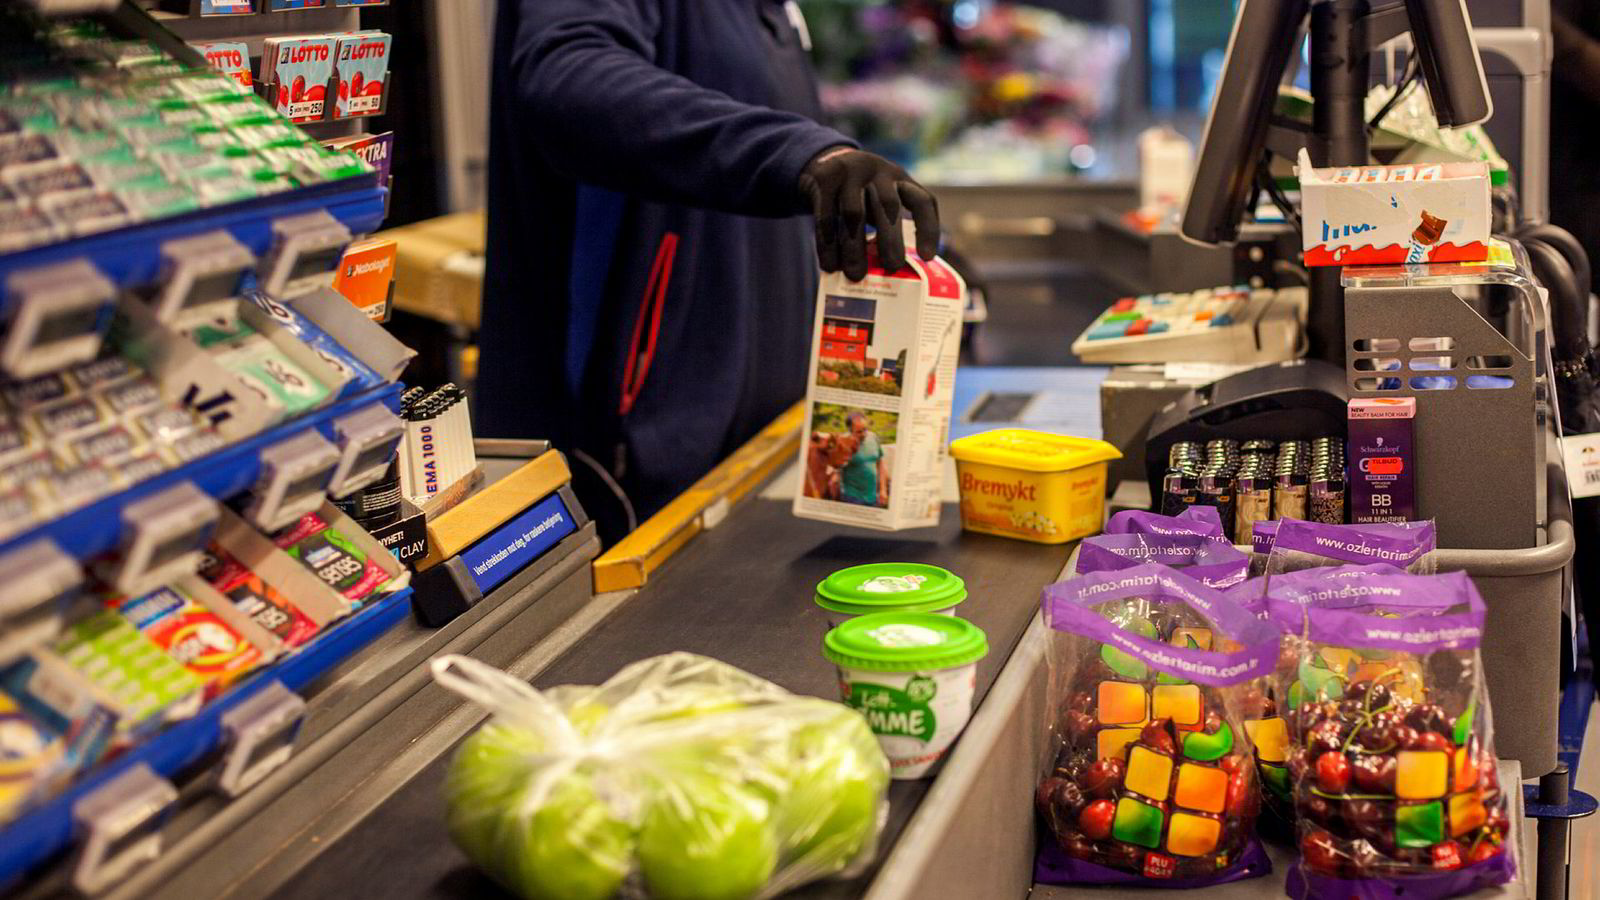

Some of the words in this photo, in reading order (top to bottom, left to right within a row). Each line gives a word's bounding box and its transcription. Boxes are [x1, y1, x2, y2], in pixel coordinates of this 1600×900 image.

[291, 44, 329, 63] LOTTO
[351, 41, 385, 60] LOTTO
[311, 103, 323, 114] 250
[1360, 446, 1400, 454] Schwarzkopf
[962, 472, 1036, 502] Bremykt
[1371, 494, 1392, 507] BB
[378, 531, 404, 547] NYHET!
[400, 540, 425, 559] CLAY
[473, 562, 488, 576] Vend
[866, 709, 926, 735] MME
